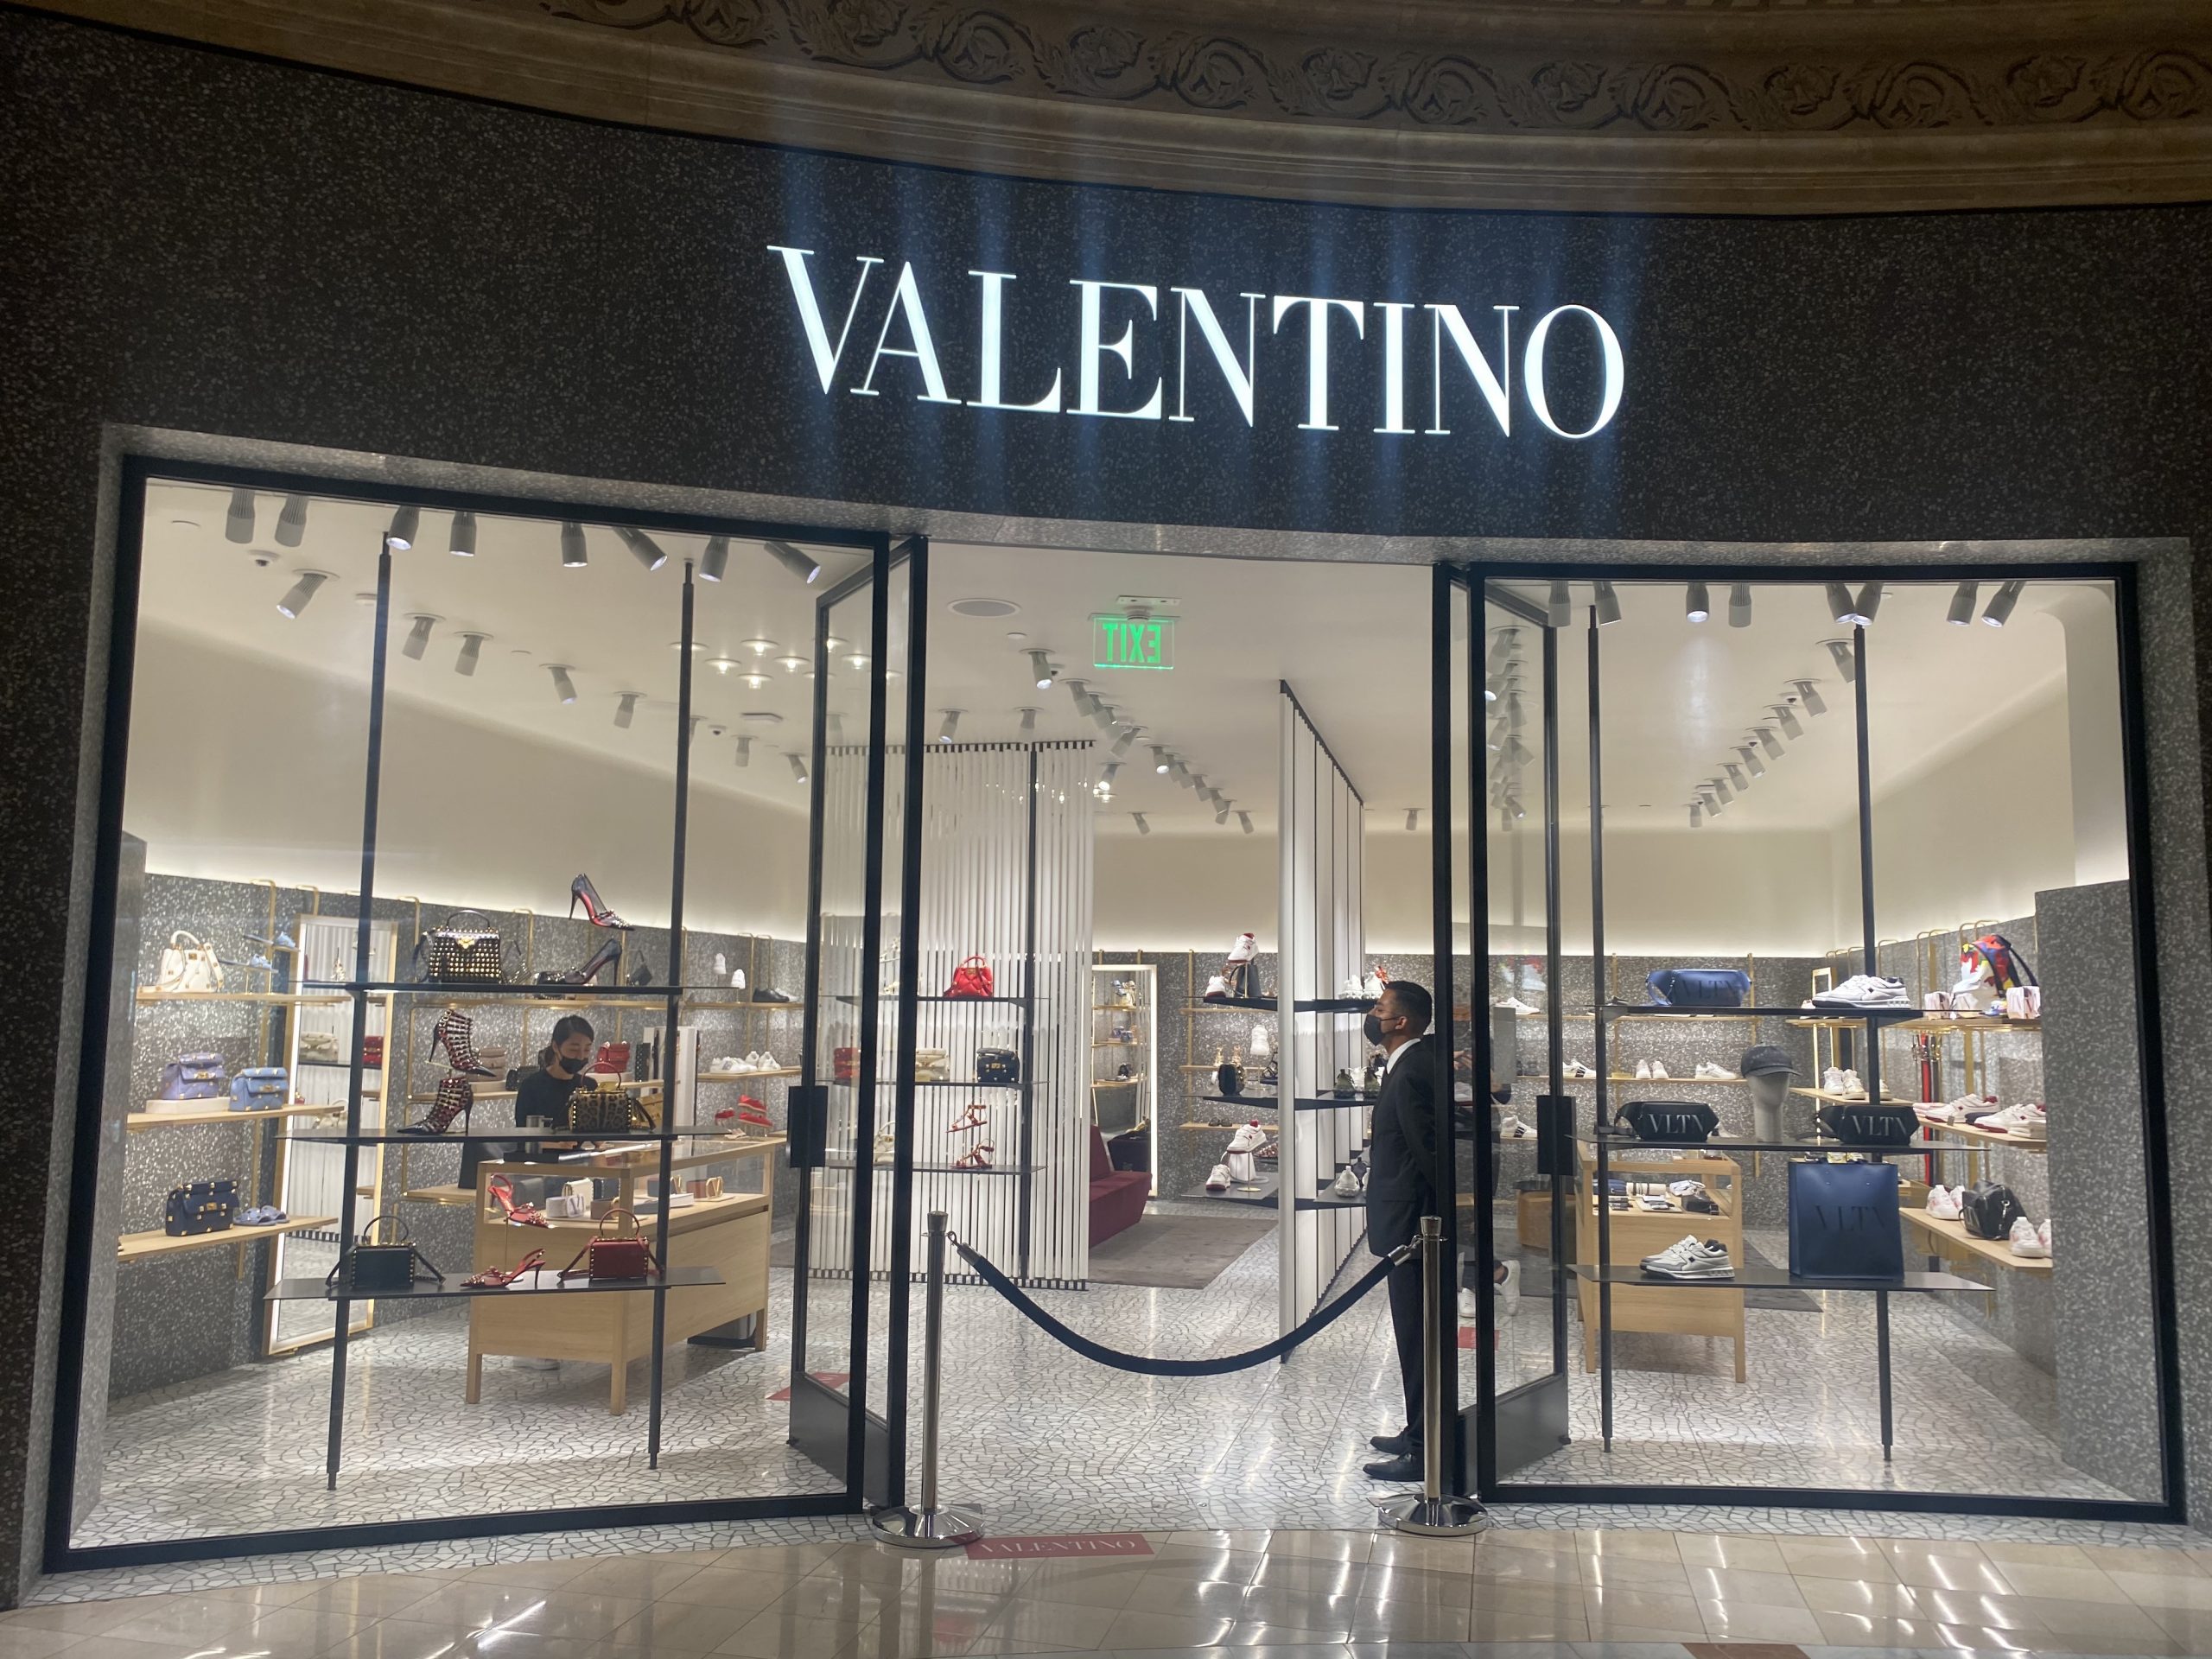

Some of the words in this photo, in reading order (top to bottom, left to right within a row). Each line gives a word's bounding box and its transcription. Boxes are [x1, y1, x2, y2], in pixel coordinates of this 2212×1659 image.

[766, 245, 1625, 440] VALENTINO
[1647, 1113, 1707, 1134] VLTN
[1851, 1115, 1911, 1136] VLTN
[1815, 1203, 1887, 1231] VLTN
[981, 1539, 1135, 1554] VALENTINO
